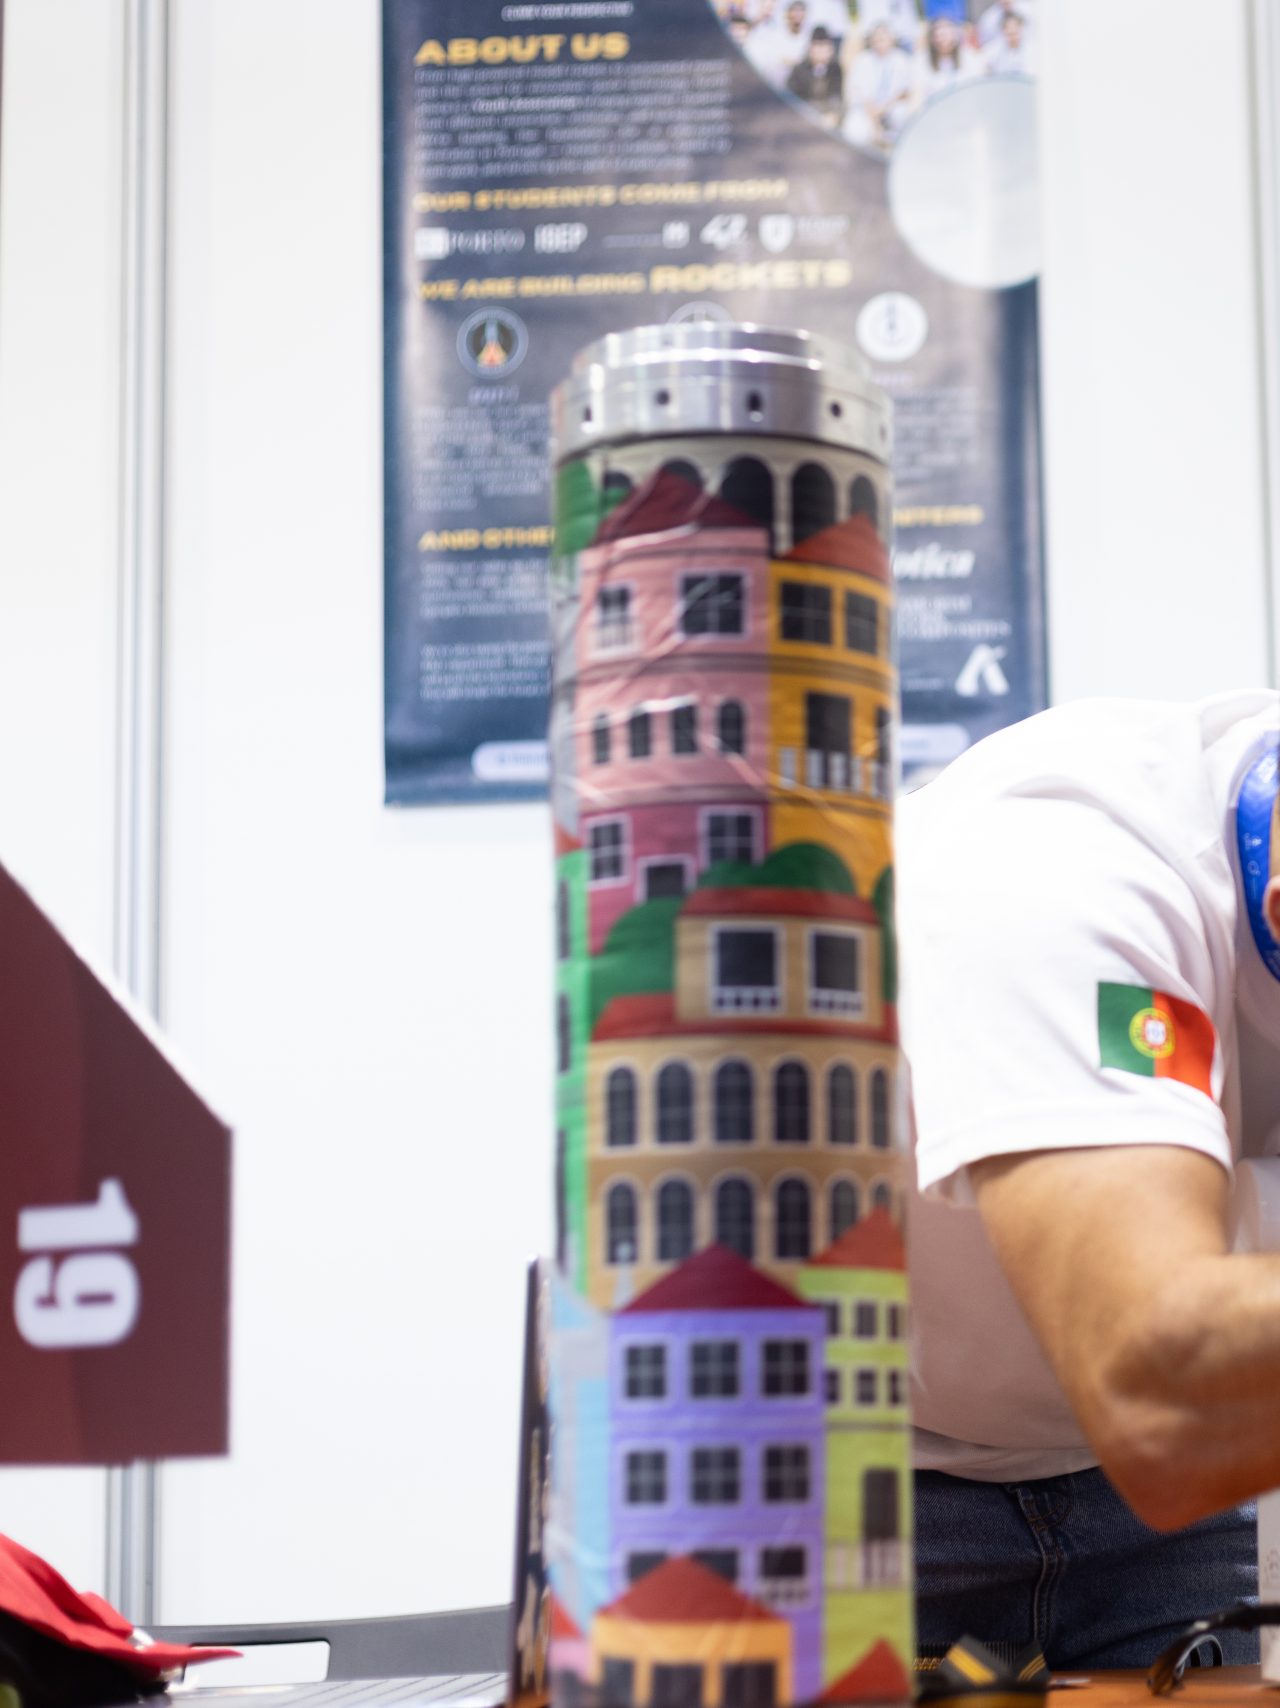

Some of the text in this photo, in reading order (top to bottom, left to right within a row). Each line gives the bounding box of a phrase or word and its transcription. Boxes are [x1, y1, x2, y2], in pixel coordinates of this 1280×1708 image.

[414, 31, 630, 65] ABOUT US
[415, 178, 789, 212] OUR STUDENTS COME FROM
[420, 259, 852, 300] WE ARE BUILDING ROCKETS
[418, 529, 481, 551] AND
[14, 1175, 140, 1349] 19
